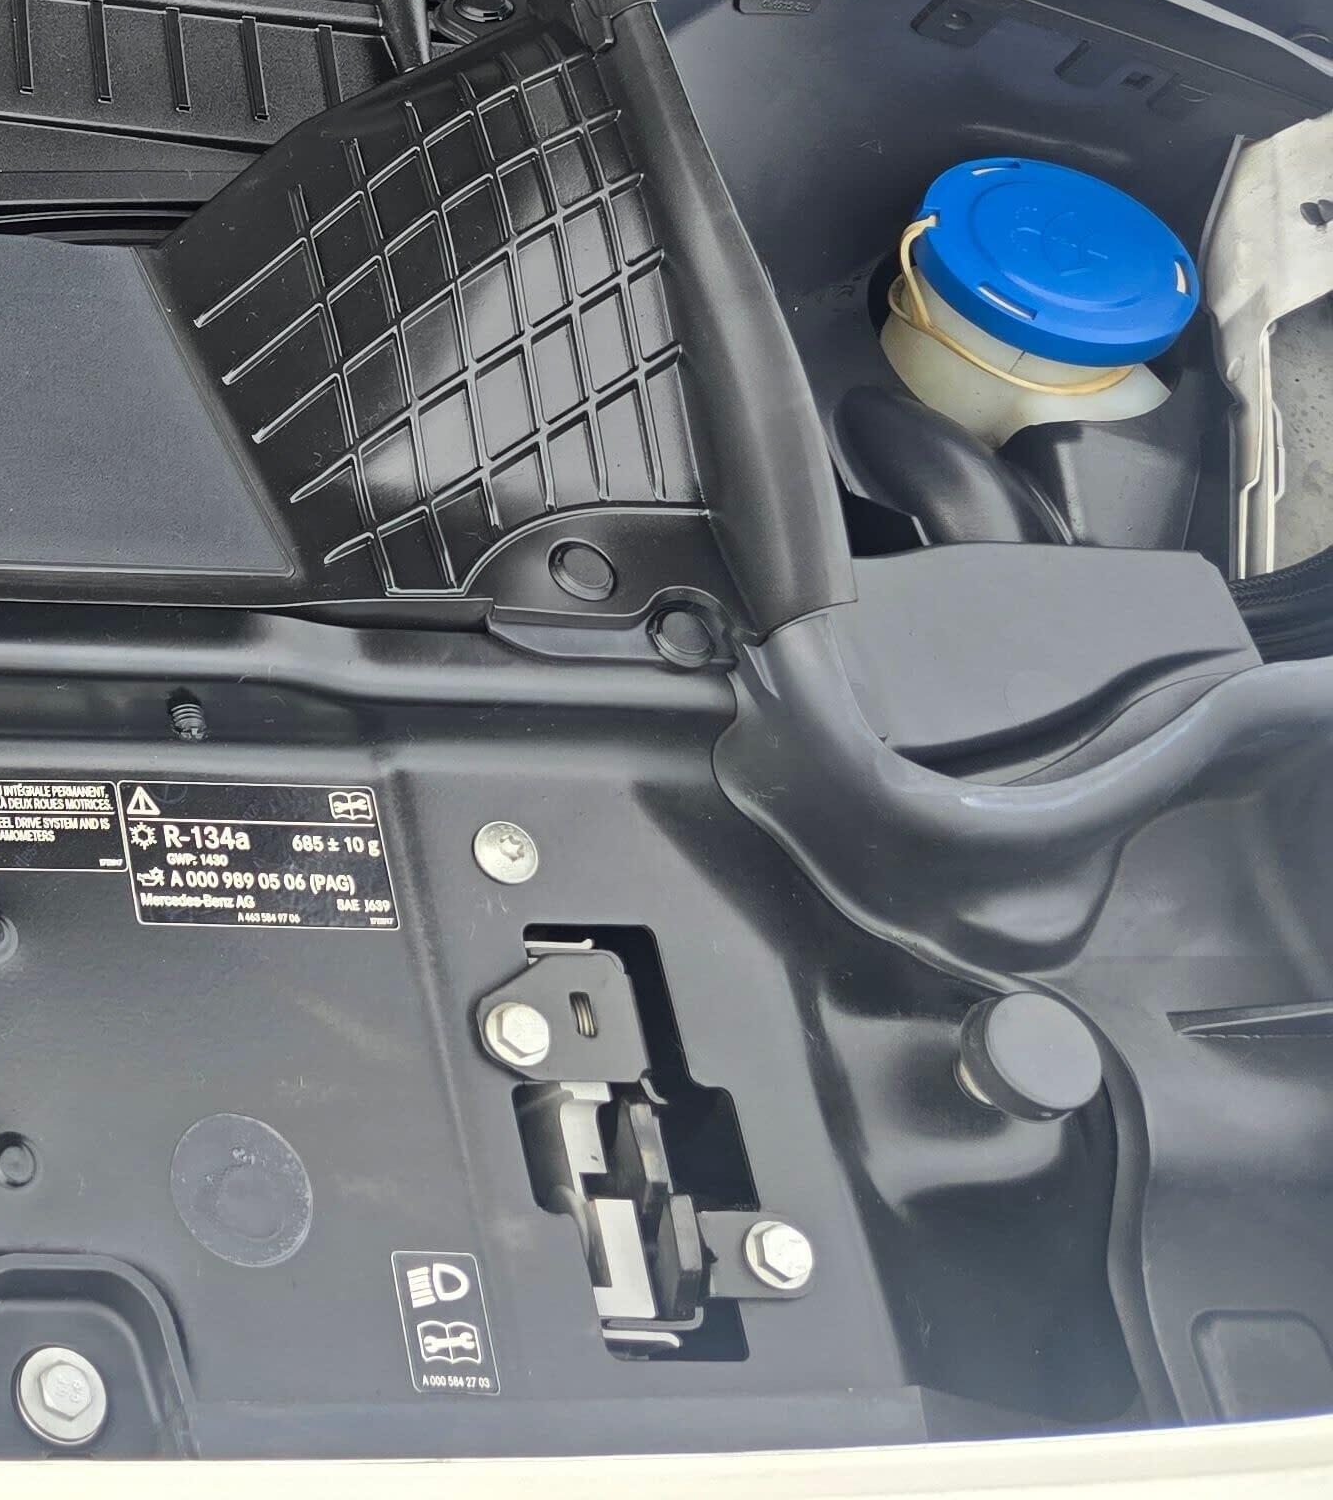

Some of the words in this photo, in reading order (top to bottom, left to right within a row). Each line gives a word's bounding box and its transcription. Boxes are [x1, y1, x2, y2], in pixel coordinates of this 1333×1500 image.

[9, 799, 33, 810] DEUX
[33, 800, 65, 811] ROUES
[15, 817, 43, 829] DRIVE
[43, 817, 78, 830] SYSTEM
[79, 818, 100, 830] AND
[100, 818, 111, 830] IS
[163, 824, 251, 850] R-134a
[292, 834, 324, 853] 685
[344, 836, 365, 853] 10
[368, 839, 381, 857] g
[200, 854, 229, 867] 1430
[171, 872, 183, 887] A
[186, 871, 219, 888] 000
[221, 872, 255, 889] 989
[258, 872, 281, 890] 05
[283, 873, 306, 891] 06
[310, 873, 356, 895] (PAG)
[140, 892, 234, 908] Mercedes-Benz
[236, 895, 255, 909] AG
[336, 898, 360, 911] SAE
[422, 1375, 430, 1386] A
[430, 1375, 447, 1386] 000
[447, 1375, 464, 1387] 584
[465, 1376, 477, 1388] 27
[478, 1377, 491, 1389] 03
